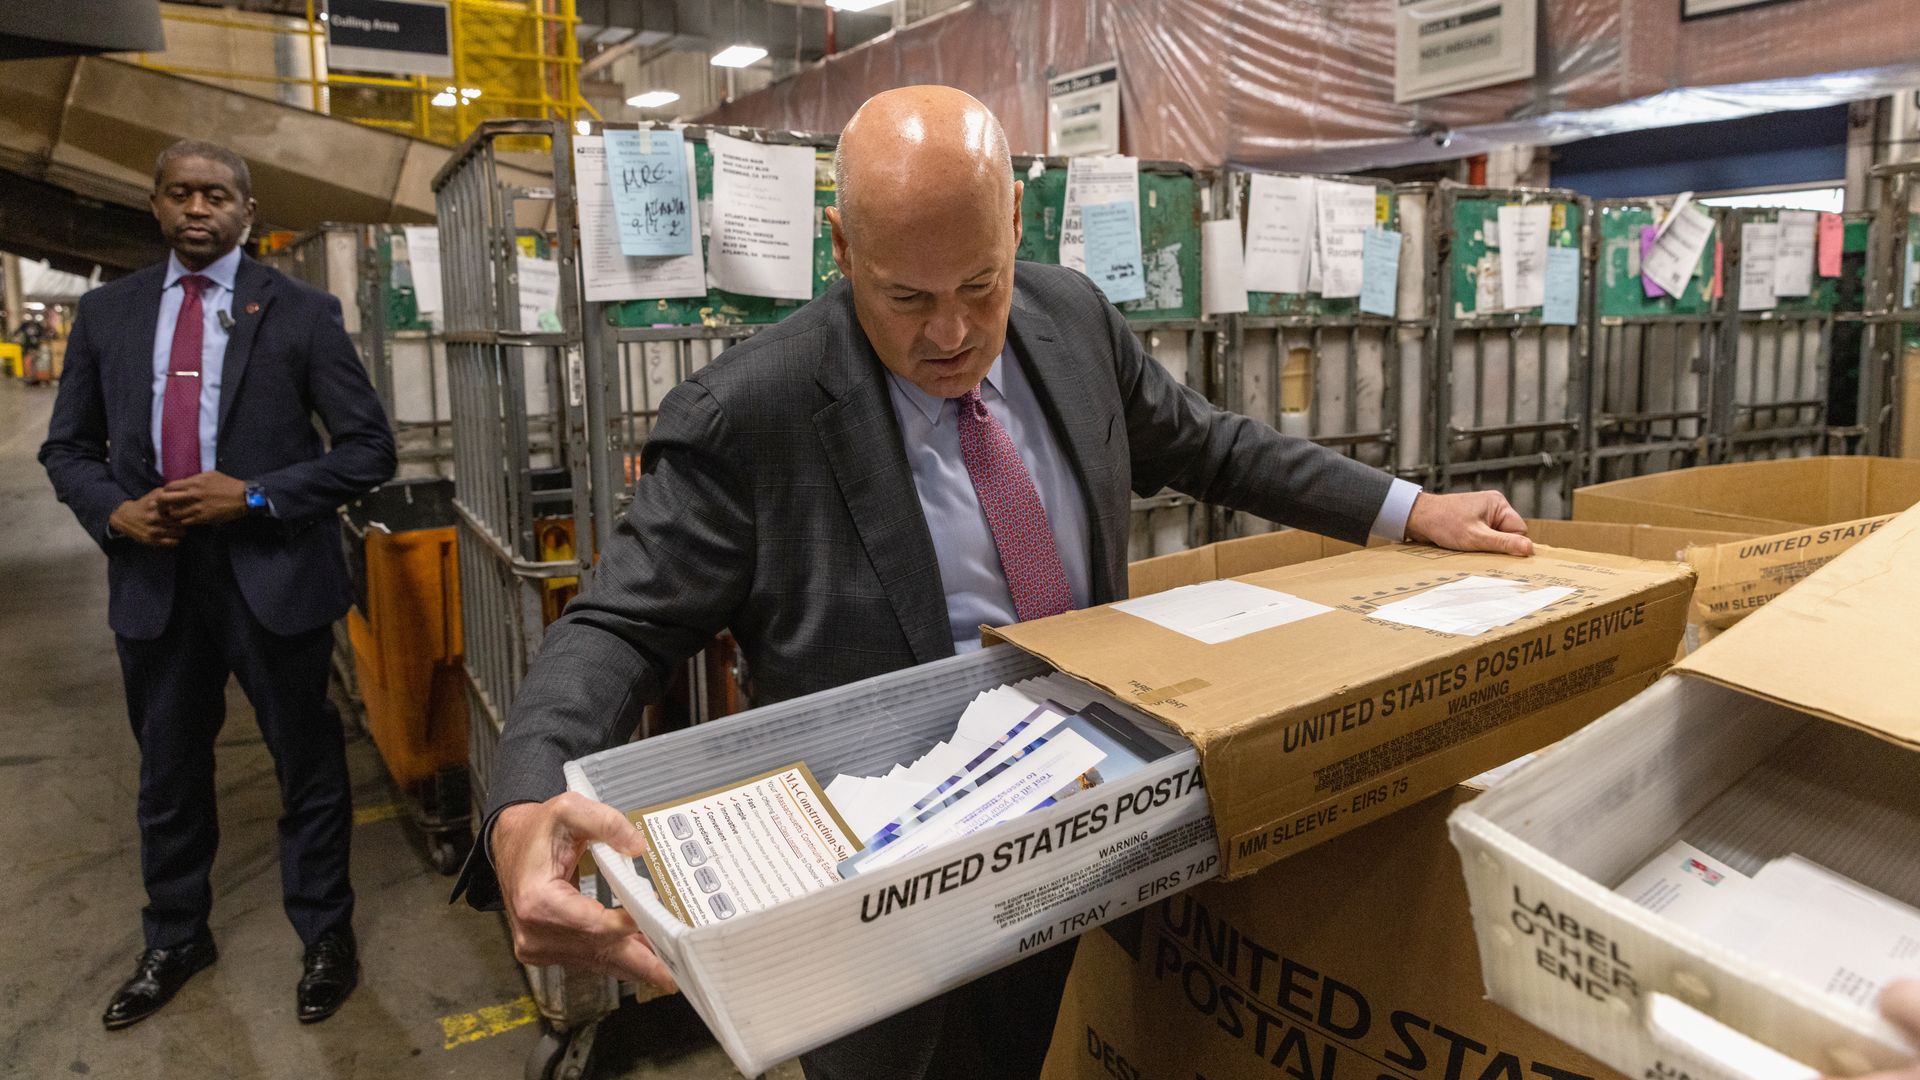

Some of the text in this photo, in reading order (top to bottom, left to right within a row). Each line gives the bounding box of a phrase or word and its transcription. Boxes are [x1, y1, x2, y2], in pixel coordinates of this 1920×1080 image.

[331, 14, 400, 33] Culling Area
[1326, 236, 1344, 245] Mail
[1739, 534, 1812, 560] UNITED
[1710, 602, 1729, 613] MM
[1127, 679, 1153, 693] TARE
[1282, 601, 1647, 754] UNITED STATES POSTAL SERVICE
[1448, 679, 1510, 717] WARNING
[1020, 784, 1032, 795] all
[1025, 771, 1037, 780] to
[1032, 770, 1053, 787] Test
[732, 802, 747, 821] Simple
[746, 798, 756, 809] Fast
[1009, 792, 1020, 802] of
[635, 821, 643, 831] Go
[692, 815, 712, 845] Accredited
[705, 811, 727, 842] Convenient
[719, 806, 739, 835] Innovative
[755, 785, 764, 795] Now
[760, 795, 776, 814] Offering
[788, 836, 805, 857] Locations
[805, 862, 820, 879] Choose
[765, 780, 779, 793] Your
[774, 793, 805, 832] Massachusetts
[799, 832, 825, 863] Continuing
[1237, 834, 1268, 861] MM
[1272, 804, 1338, 847] SLEEVE
[1351, 783, 1389, 815] EIRS
[1391, 776, 1410, 798] 75
[1098, 831, 1149, 859] WARNING
[860, 852, 985, 924] UNITED
[990, 803, 1109, 874] STATES
[994, 900, 1006, 909] THIS
[1006, 887, 1037, 903] EQUIPMENT
[1037, 882, 1049, 890] MAY
[1049, 877, 1061, 885] NOT
[1069, 867, 1084, 877] SOLD
[1091, 853, 1116, 868] RECYCLED
[1118, 844, 1139, 856] WITHOUT
[992, 903, 1025, 920] PROHIBITED
[1033, 890, 1056, 903] FEDERAL
[1071, 879, 1081, 887] THE
[1082, 871, 1100, 882] POSTAL
[1023, 894, 1035, 902] THIS
[1036, 881, 1064, 896] EQUIPMENT
[1065, 876, 1076, 884] FOR
[1078, 871, 1087, 879] ANY
[1088, 862, 1110, 874] PURPOSE
[996, 905, 1032, 924] TECHNOLOGY
[1041, 892, 1064, 905] MONITOR
[1064, 887, 1075, 895] THE
[1075, 877, 1099, 890] LOCATION
[1018, 926, 1054, 954] MM
[1059, 900, 1113, 936] TRAY
[1137, 872, 1181, 902] EIRS
[1186, 854, 1218, 884] 74P
[1041, 891, 1079, 910] IMPRISONMENT
[1513, 885, 1632, 970] LABEL
[1159, 892, 1372, 1040] UNITED
[1511, 909, 1639, 997] OTHER
